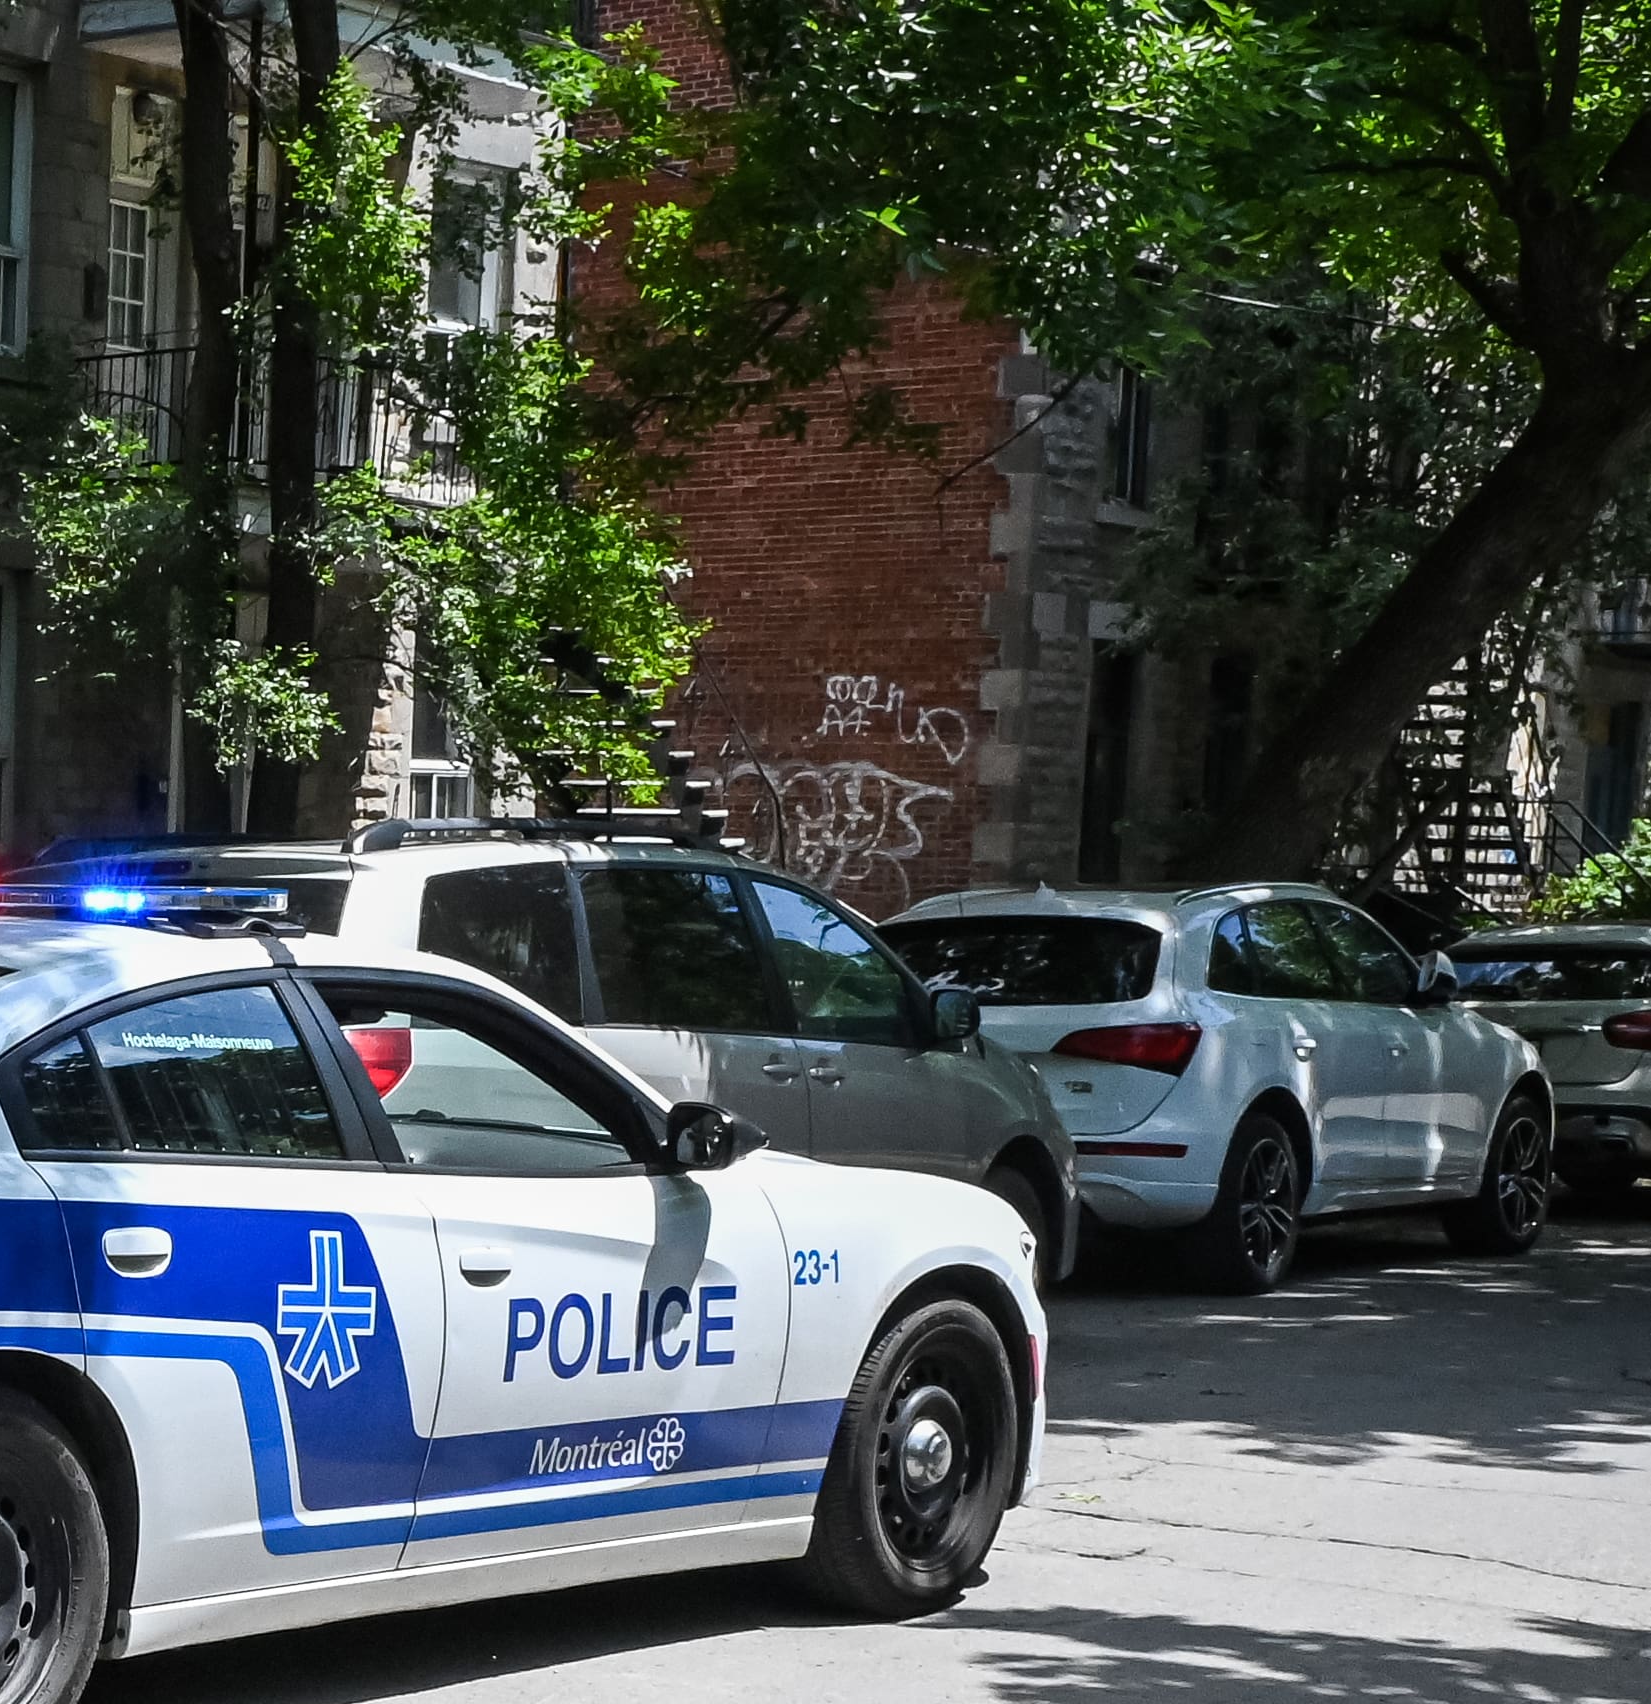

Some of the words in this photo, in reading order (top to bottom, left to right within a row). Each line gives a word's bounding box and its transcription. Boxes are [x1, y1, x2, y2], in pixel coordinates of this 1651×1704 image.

[121, 1031, 274, 1052] Hochelaga-Maisonneuve
[792, 1248, 842, 1286] 23-1
[502, 1284, 737, 1384] POLICE
[529, 1426, 645, 1476] Montréal
